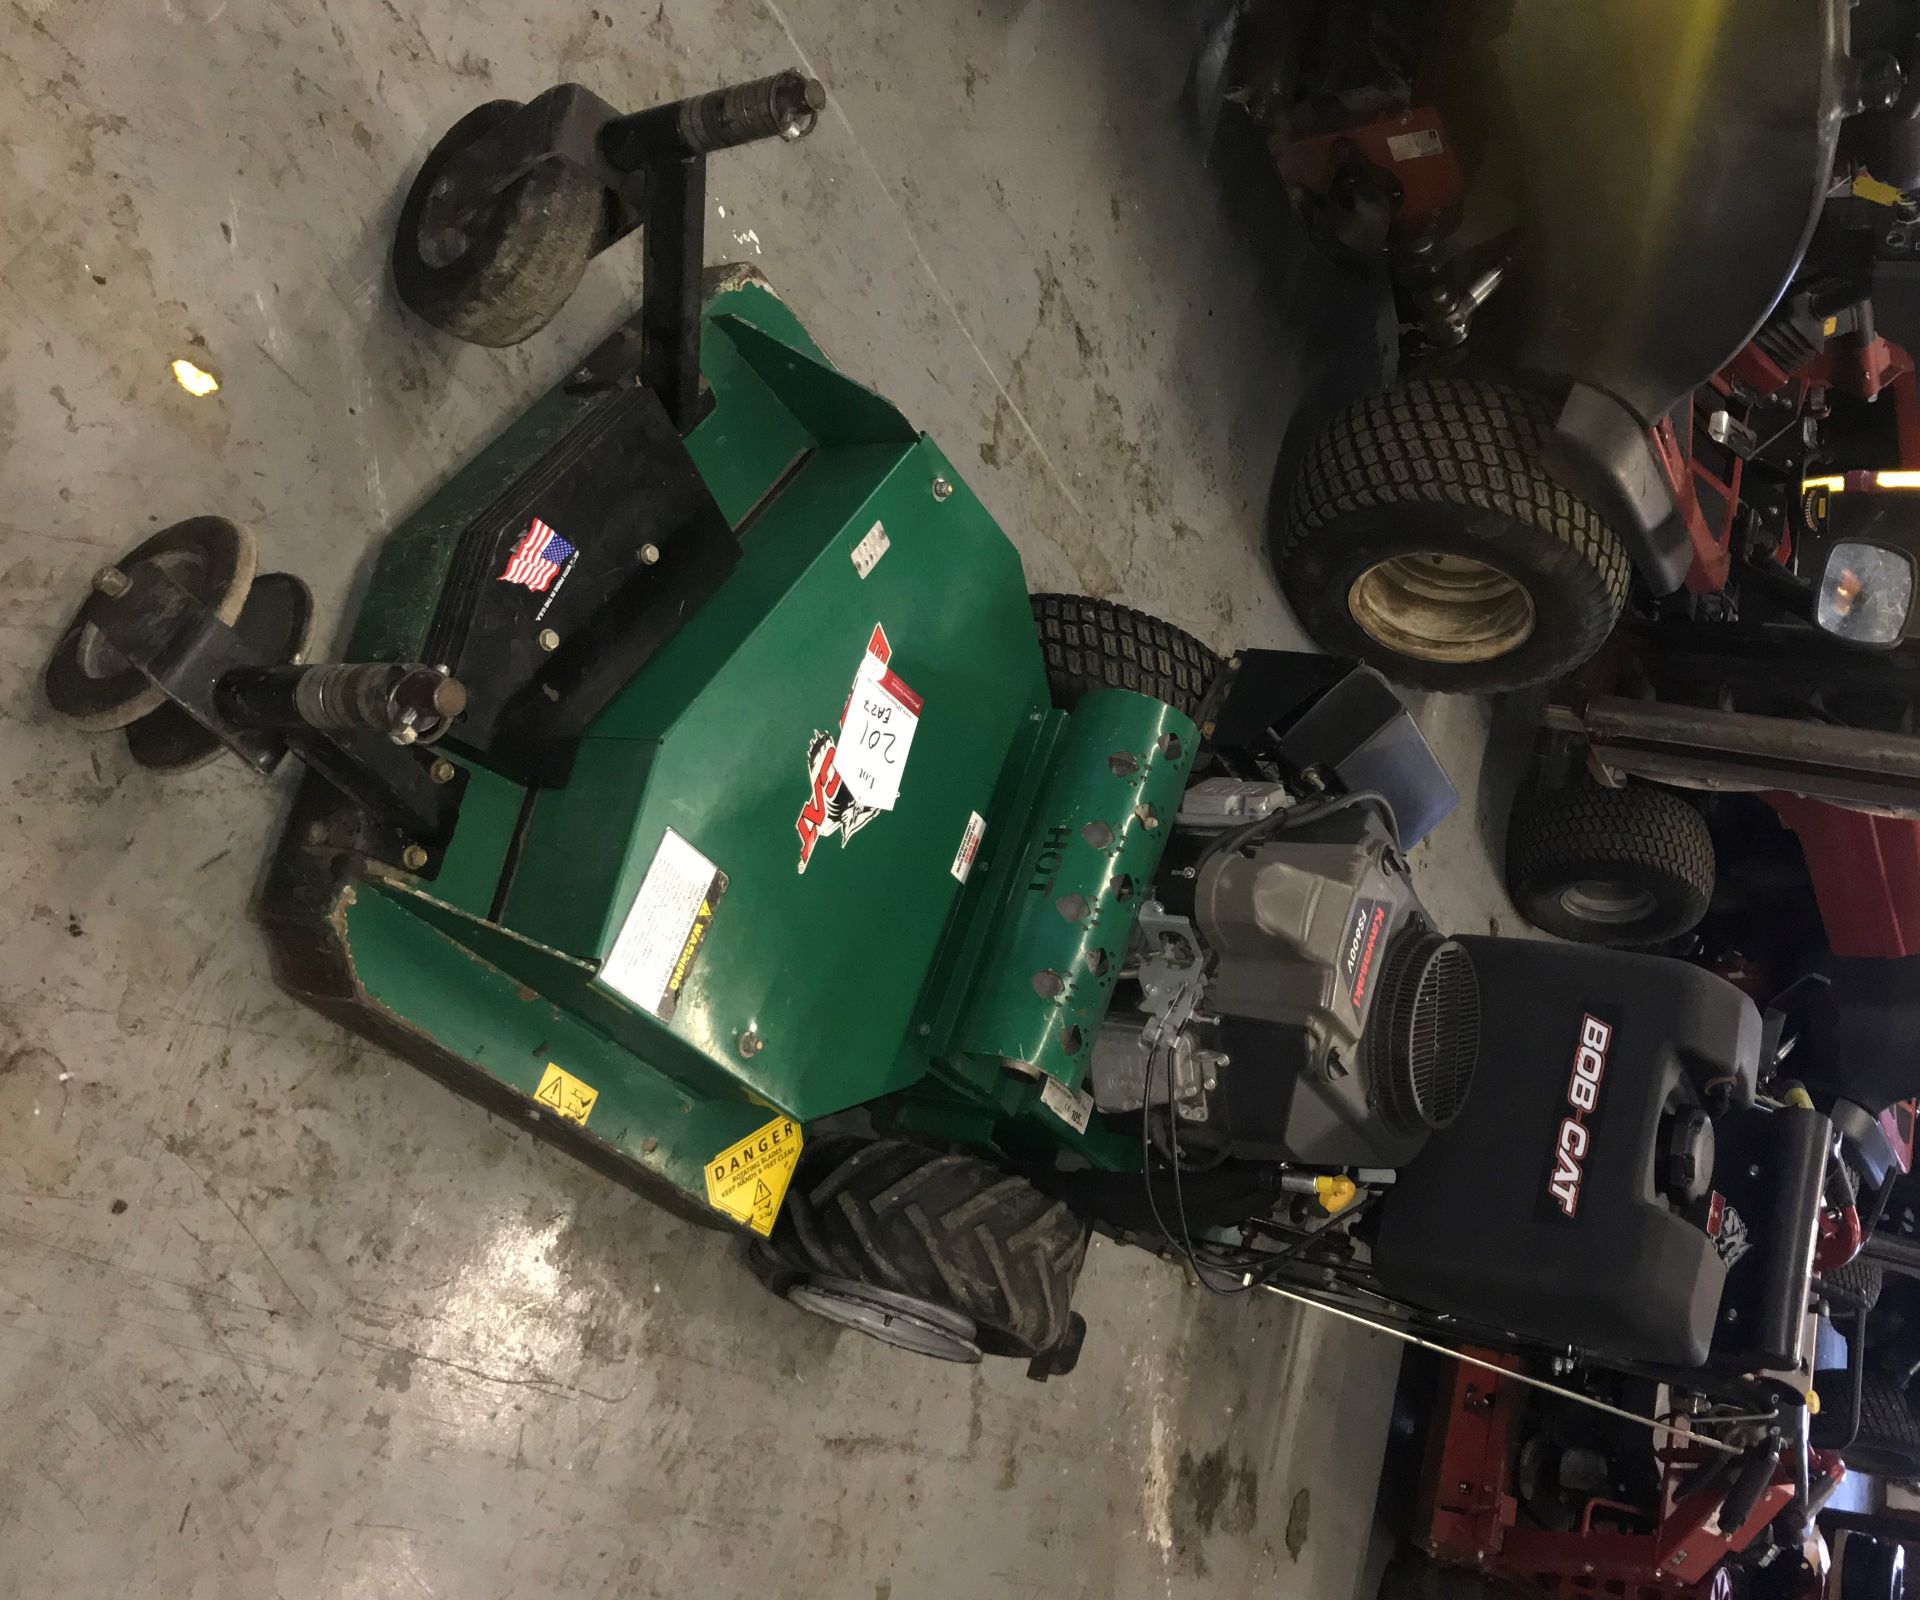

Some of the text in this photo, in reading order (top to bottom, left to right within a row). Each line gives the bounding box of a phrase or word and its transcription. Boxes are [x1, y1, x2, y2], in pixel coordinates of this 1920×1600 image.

[860, 720, 897, 764] 201
[858, 767, 876, 789] Lot
[1028, 828, 1073, 896] HOT
[670, 923, 703, 990] WARNING
[1347, 908, 1367, 974] FS600V
[1353, 906, 1385, 1008] Kawasaki
[1549, 1012, 1613, 1218] BOB-CAT
[715, 1122, 793, 1181] DANGER
[722, 1186, 736, 1198] KEEP
[737, 1172, 757, 1188] HANDS
[763, 1159, 777, 1170] FEET
[777, 1147, 795, 1162] CLEAR
[732, 1146, 783, 1182] ROTATING BLADES
